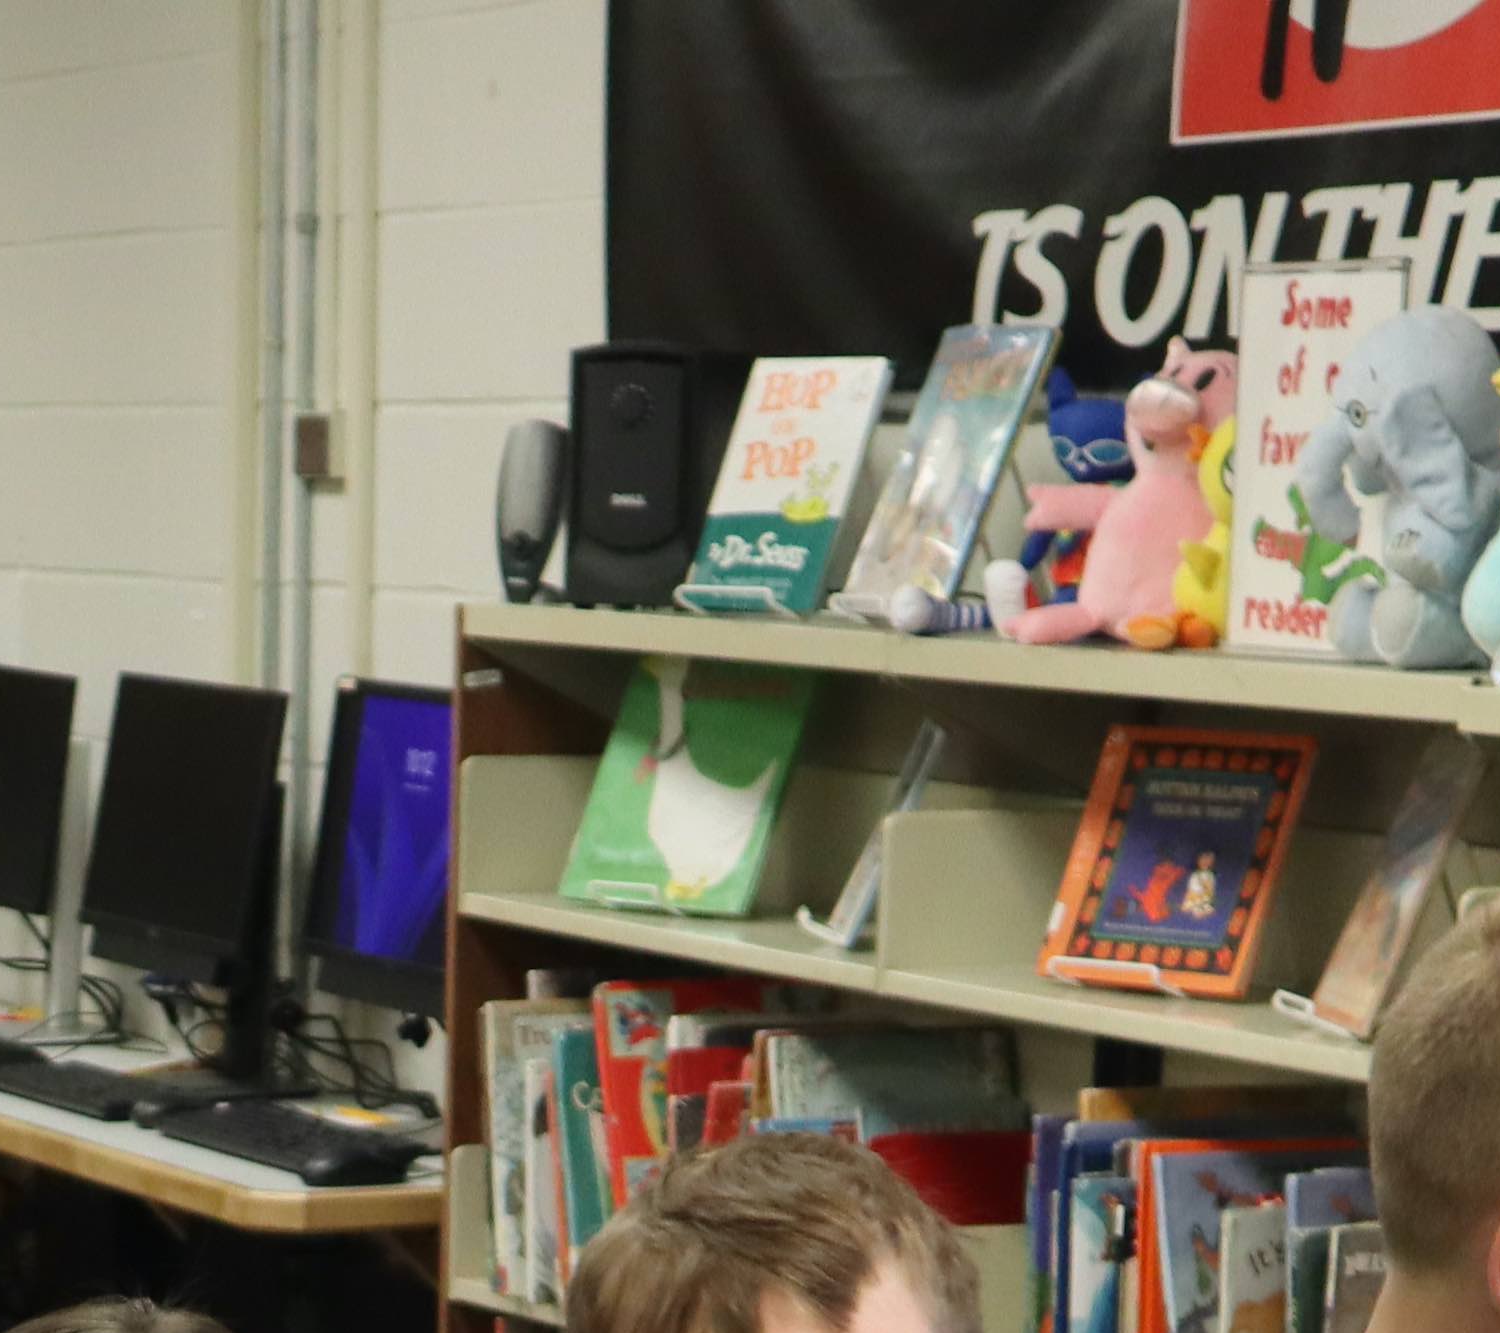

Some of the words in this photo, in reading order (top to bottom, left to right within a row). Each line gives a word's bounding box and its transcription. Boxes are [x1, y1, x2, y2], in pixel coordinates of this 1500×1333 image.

[972, 205, 1084, 327] IS
[1094, 191, 1289, 347] ON
[1281, 279, 1352, 329] Some
[1278, 345, 1306, 396] of
[740, 437, 816, 481] POP
